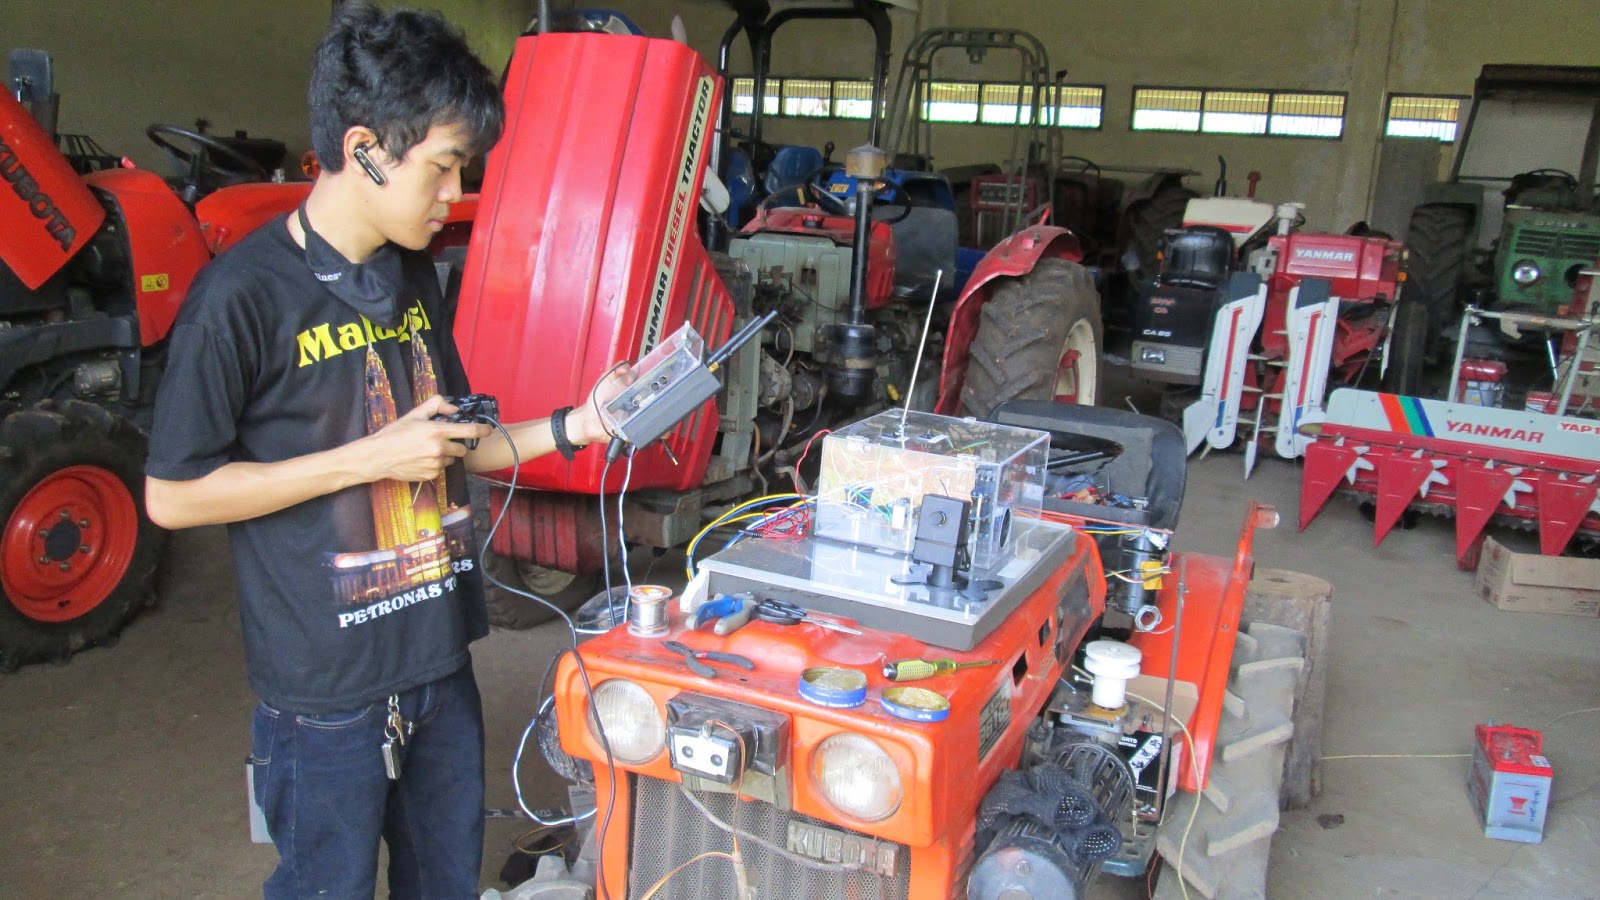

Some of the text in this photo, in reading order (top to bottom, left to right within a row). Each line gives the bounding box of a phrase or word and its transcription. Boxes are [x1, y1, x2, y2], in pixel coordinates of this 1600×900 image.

[644, 80, 710, 356] ANMAR DIESEL TRACTOR
[1296, 249, 1354, 261] YANMAR
[1446, 420, 1545, 444] YANMAR
[338, 583, 443, 629] PETRONAS
[787, 820, 898, 877] KUBOTA
